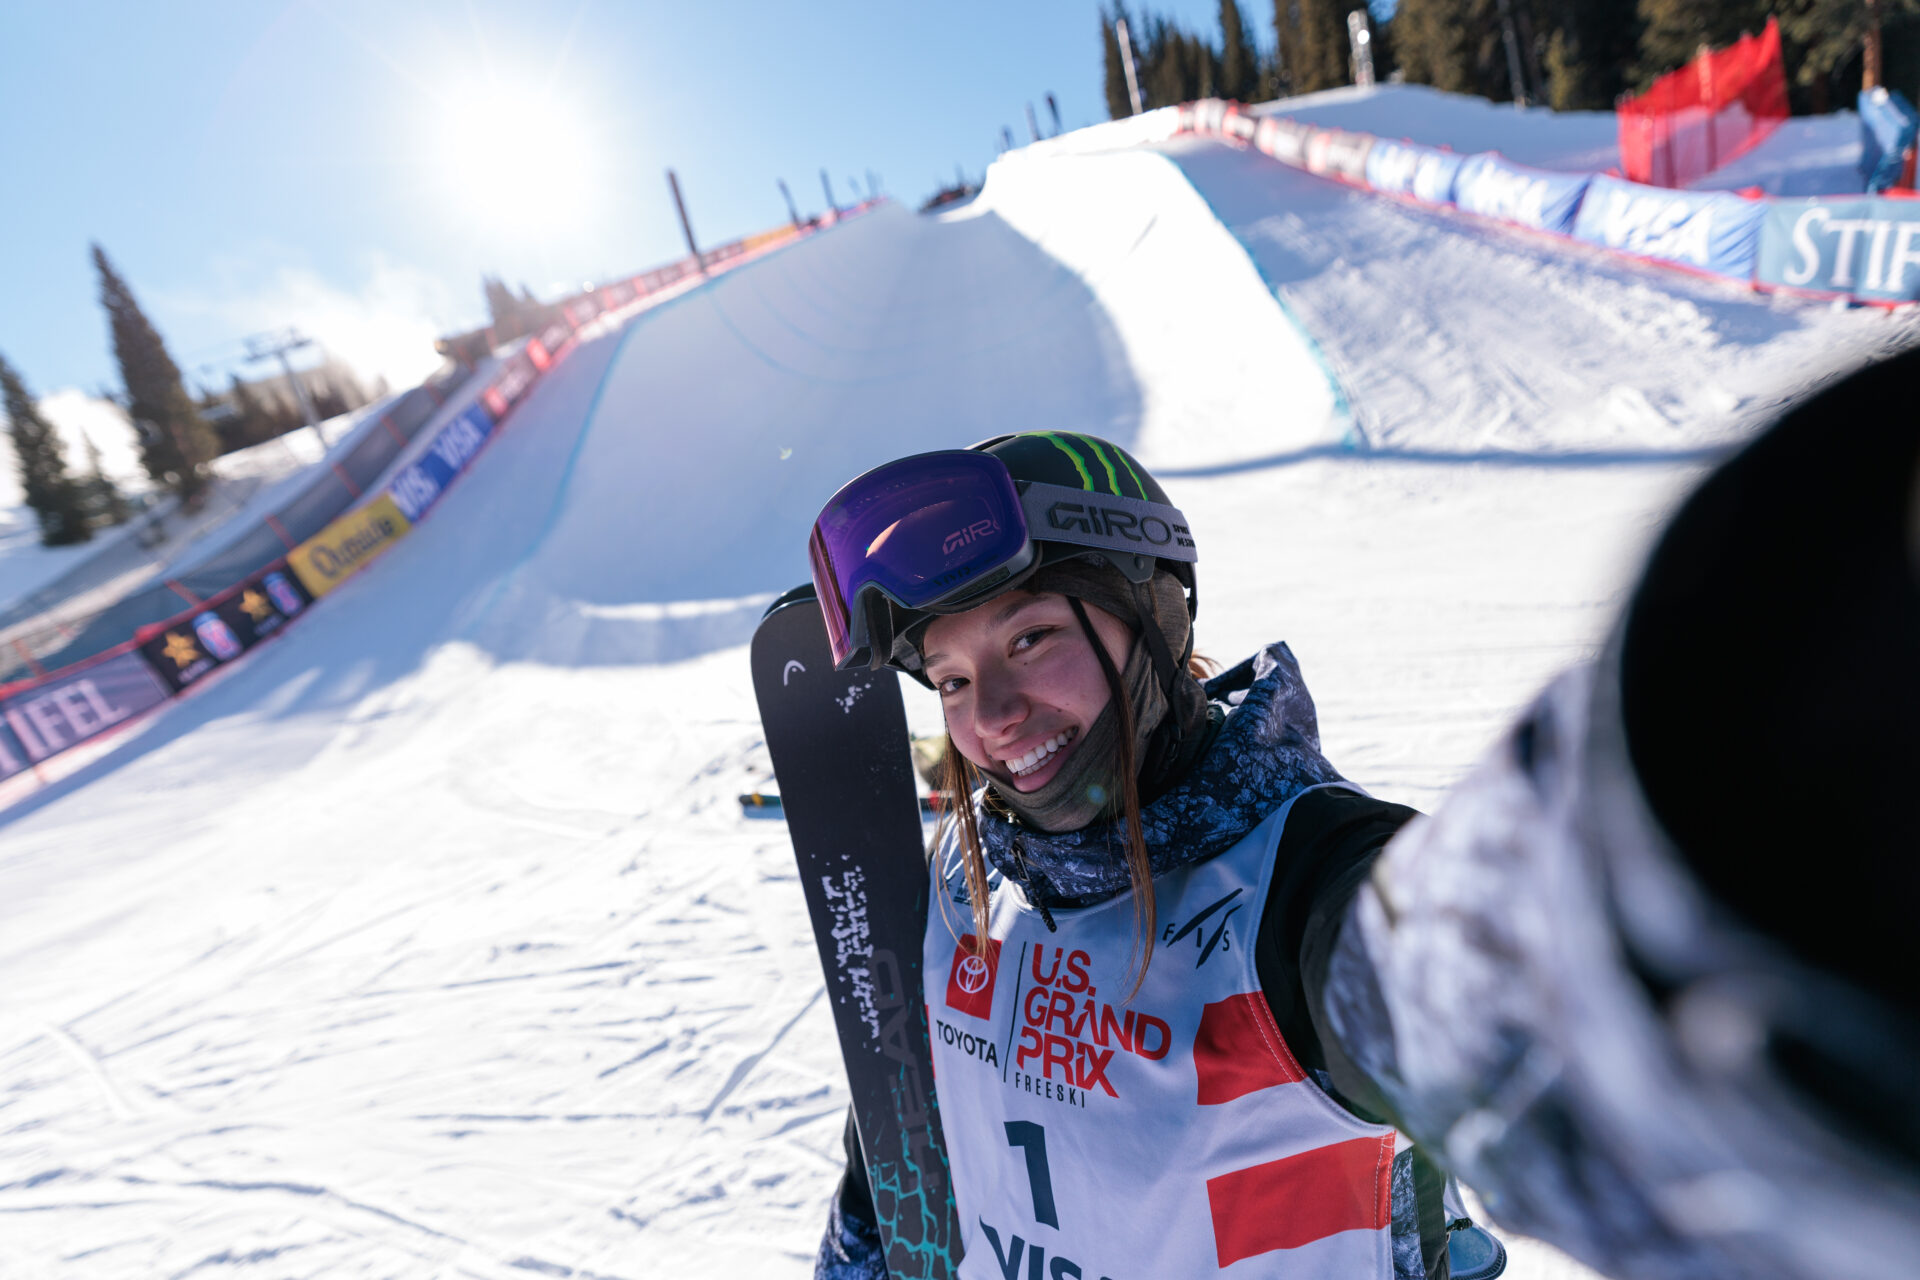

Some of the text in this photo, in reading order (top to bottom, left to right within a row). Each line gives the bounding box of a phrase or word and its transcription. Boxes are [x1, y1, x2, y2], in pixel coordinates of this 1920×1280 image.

[1050, 502, 1171, 546] GIRO
[1032, 943, 1097, 998] U.S.
[936, 1019, 999, 1069] TOYOTA
[1024, 987, 1172, 1061] GRAND
[1015, 1072, 1085, 1108] FREESKI
[1016, 1025, 1120, 1099] PRIX
[1003, 1120, 1060, 1231] 1
[979, 1214, 1112, 1280] VI
